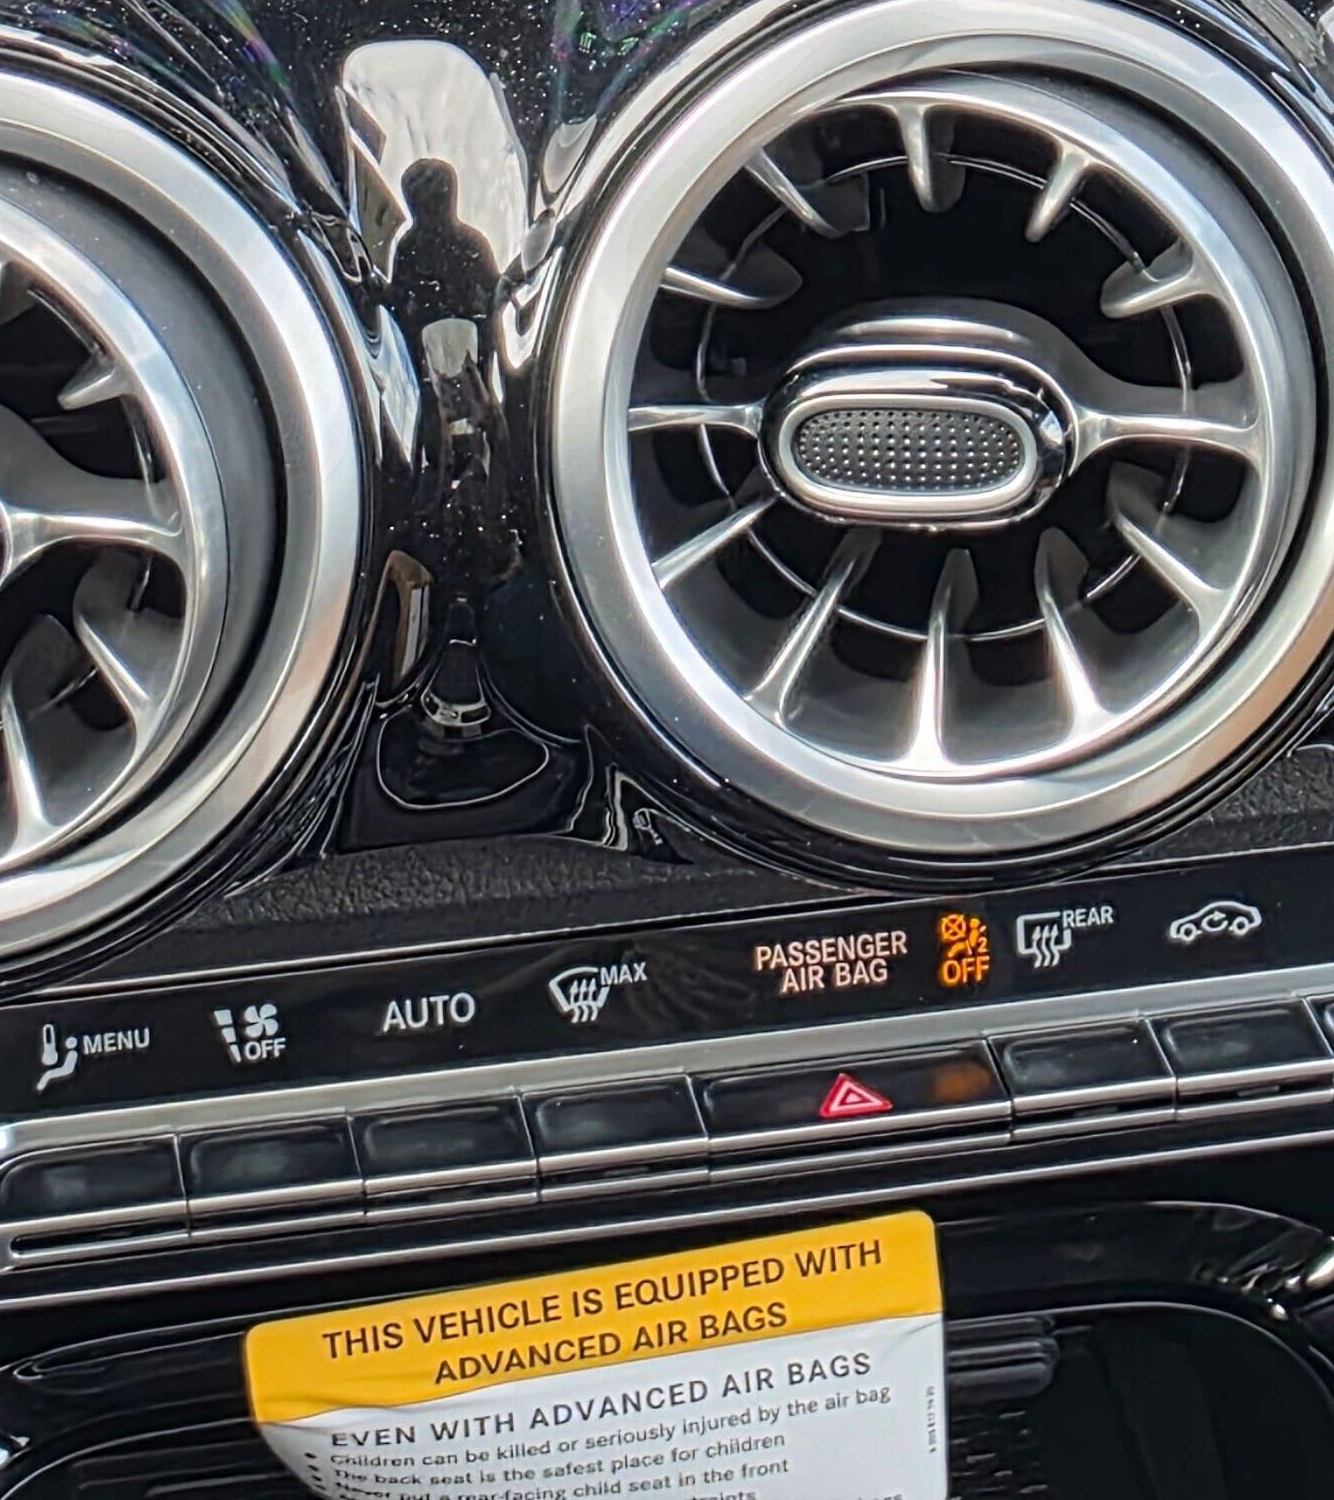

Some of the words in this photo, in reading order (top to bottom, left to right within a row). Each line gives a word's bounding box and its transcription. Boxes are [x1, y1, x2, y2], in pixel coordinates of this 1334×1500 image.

[1063, 906, 1114, 929] REAR
[756, 931, 908, 970] PASSENGER
[942, 956, 990, 984] OFF
[600, 961, 648, 986] MAX
[782, 969, 825, 992] AIR
[835, 958, 888, 985] BAG
[382, 992, 476, 1034] AUTO
[83, 1028, 151, 1054] MENU
[244, 1038, 286, 1060] OFF
[322, 1322, 404, 1359] THIS
[413, 1295, 562, 1343] VEHICLE
[572, 1288, 604, 1317] IS
[615, 1257, 785, 1310] EQUIPPED
[795, 1239, 882, 1278] WITH
[434, 1332, 622, 1385] ADVANCED
[633, 1319, 687, 1351] AIR
[700, 1301, 788, 1340] BAGS
[331, 1425, 416, 1447] EVEN
[430, 1411, 515, 1442] WITH
[529, 1380, 709, 1431] ADVANCED
[722, 1367, 774, 1398] AIR
[788, 1352, 872, 1386] BAGS
[422, 1453, 458, 1466] can
[466, 1449, 490, 1463] be
[497, 1440, 551, 1460] killed
[558, 1439, 578, 1452] or
[585, 1421, 676, 1451] seriously
[682, 1412, 753, 1437] injured
[758, 1407, 782, 1427] by
[786, 1398, 819, 1418] the
[825, 1392, 849, 1411] air
[855, 1385, 892, 1406] bag
[374, 1472, 422, 1485] back
[430, 1473, 473, 1485] seat
[480, 1470, 496, 1484] is
[503, 1468, 535, 1482] the
[542, 1458, 605, 1479] safest
[611, 1454, 665, 1475] place
[671, 1447, 699, 1464] for
[705, 1432, 786, 1459] children
[573, 1481, 621, 1498] child
[628, 1476, 671, 1493] seat
[678, 1471, 696, 1486] in
[703, 1467, 735, 1483] the
[740, 1459, 789, 1479] front
